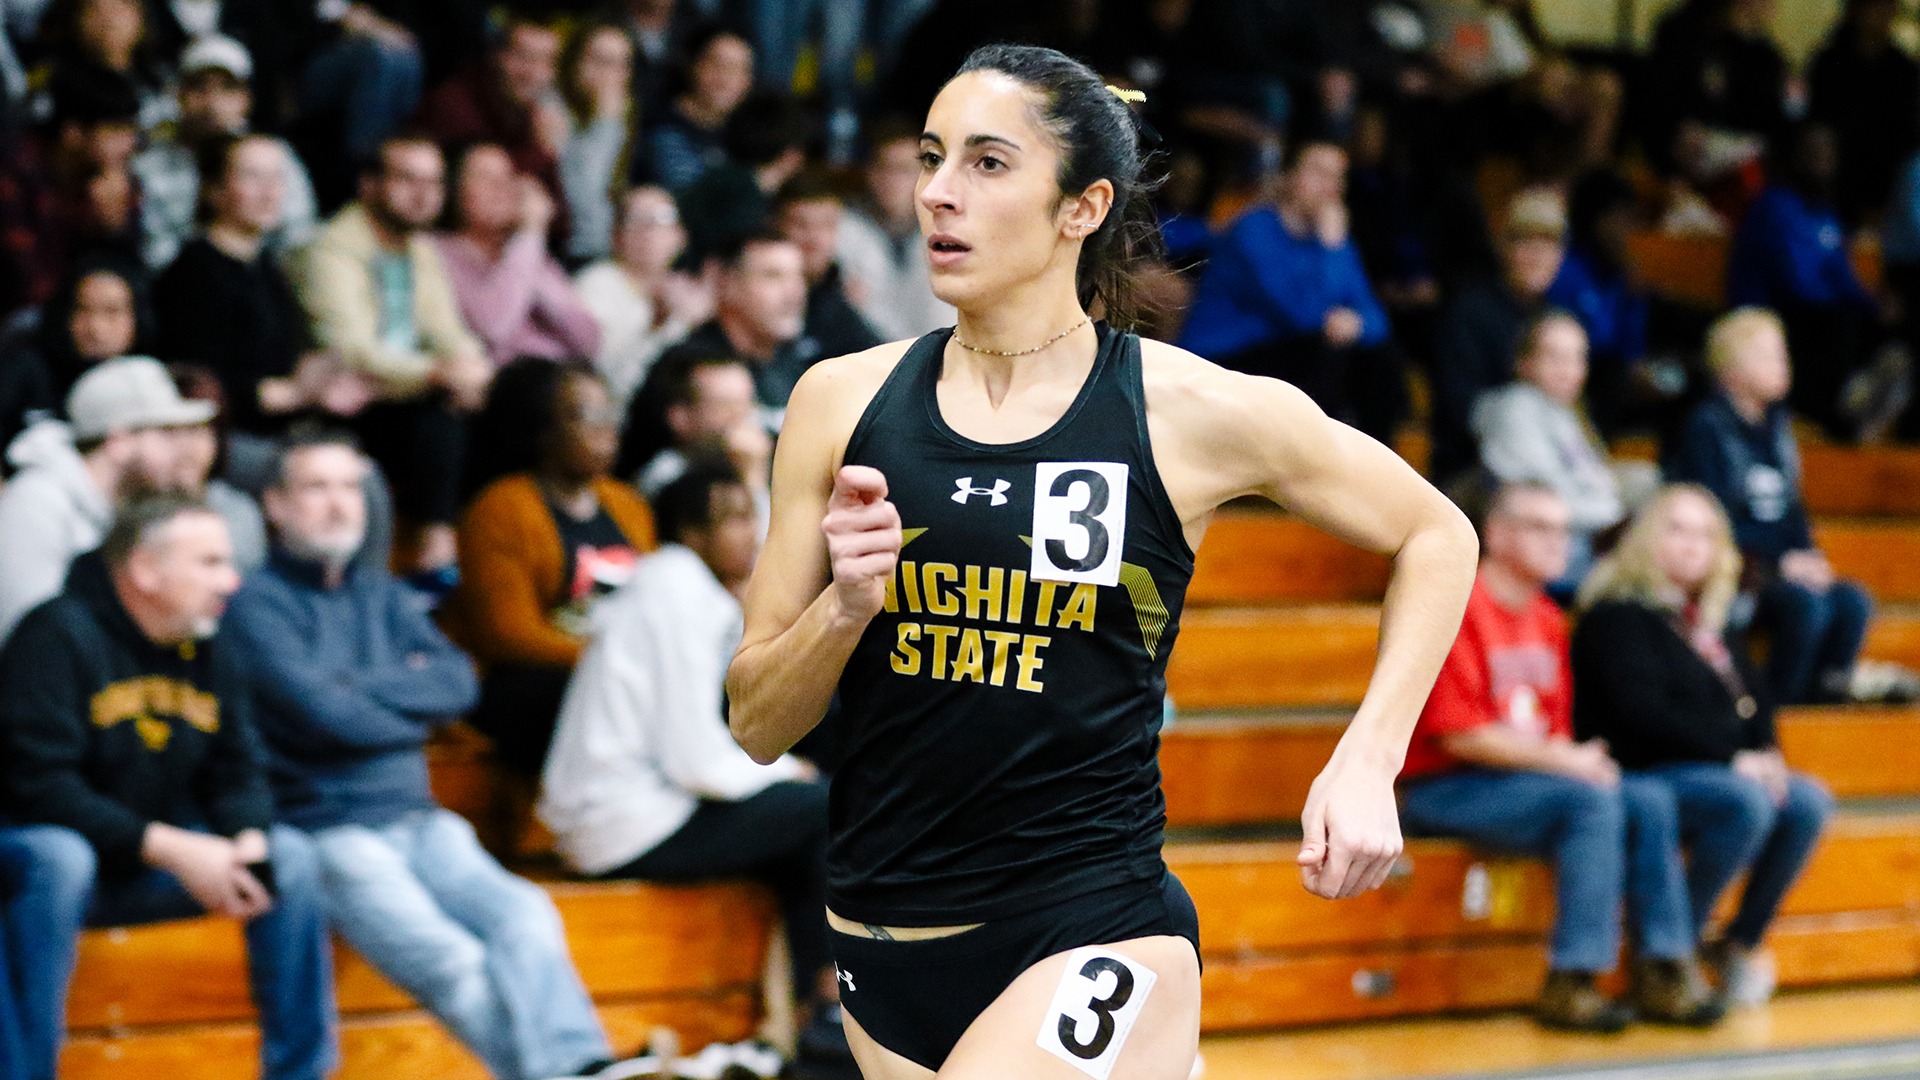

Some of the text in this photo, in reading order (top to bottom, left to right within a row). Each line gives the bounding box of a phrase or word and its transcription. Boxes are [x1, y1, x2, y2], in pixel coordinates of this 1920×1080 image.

[1044, 469, 1110, 573] 3
[890, 622, 1052, 693] STATE
[1057, 956, 1135, 1060] 3
